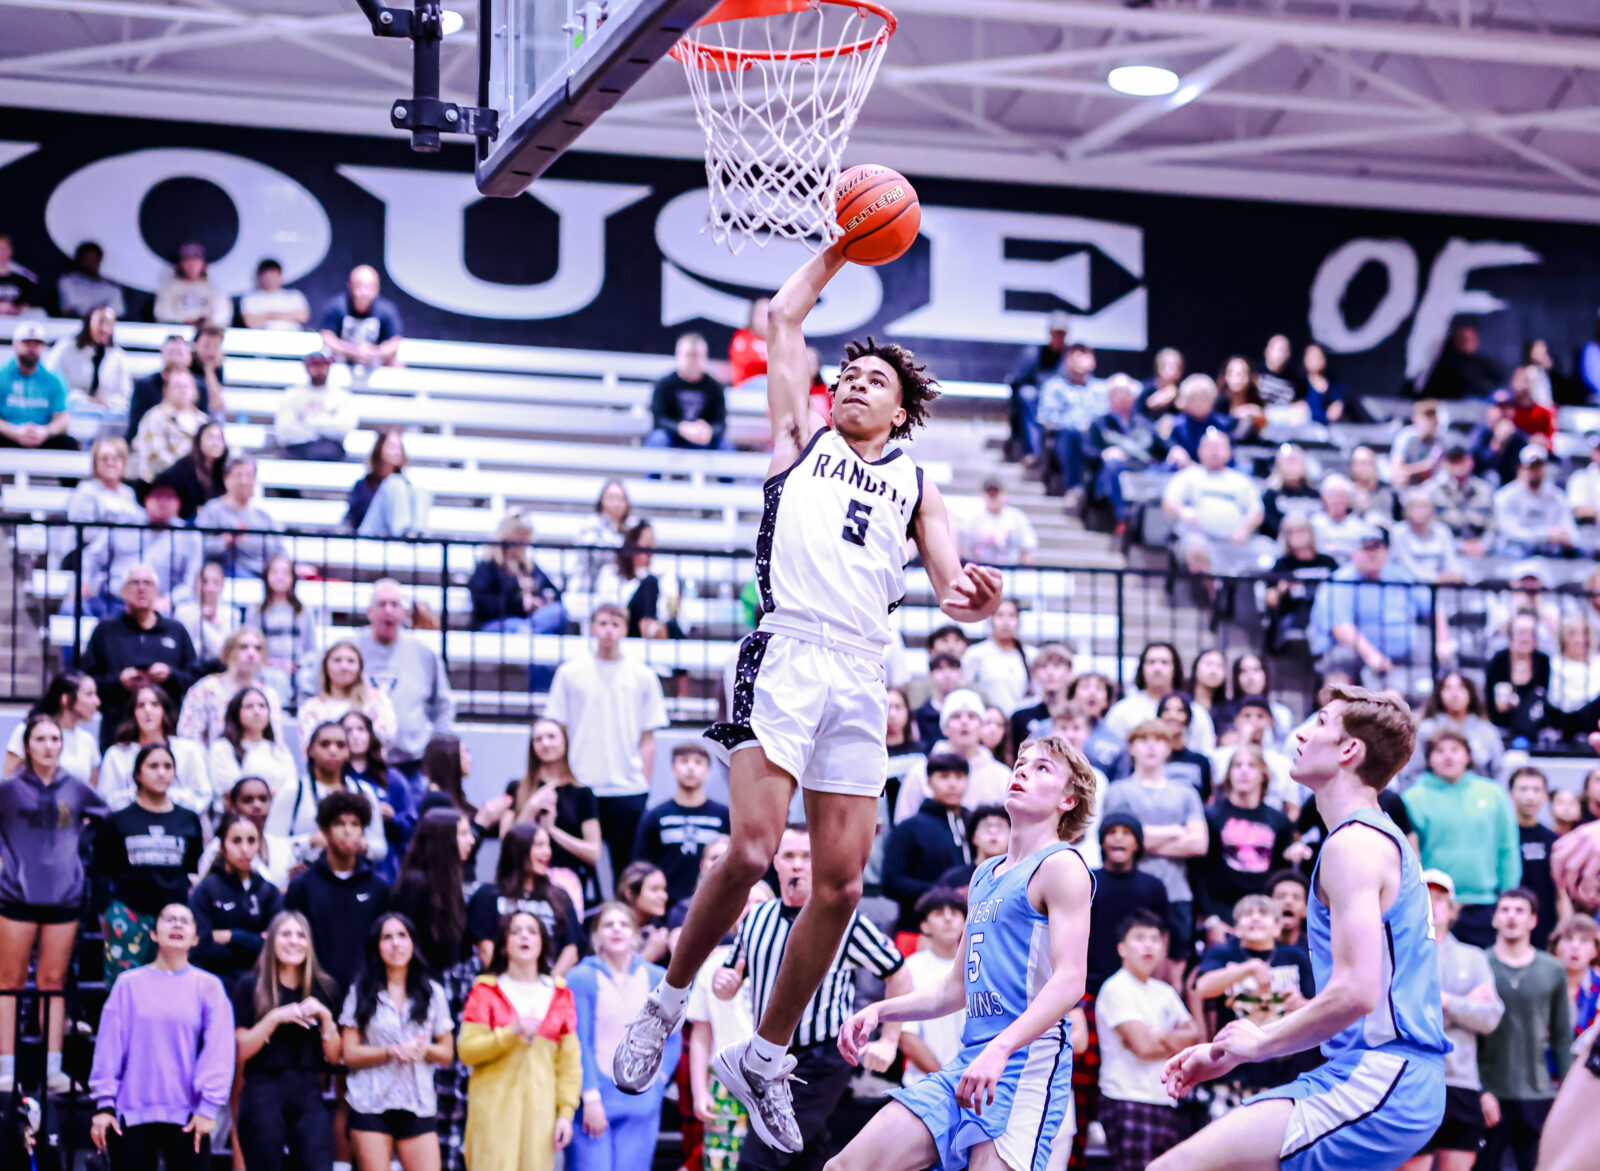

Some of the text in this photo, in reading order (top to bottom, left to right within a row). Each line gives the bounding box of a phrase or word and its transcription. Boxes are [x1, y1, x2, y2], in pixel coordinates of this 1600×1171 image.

[0, 141, 1541, 393] OUSE OF
[842, 498, 872, 546] 5
[968, 932, 984, 983] 5
